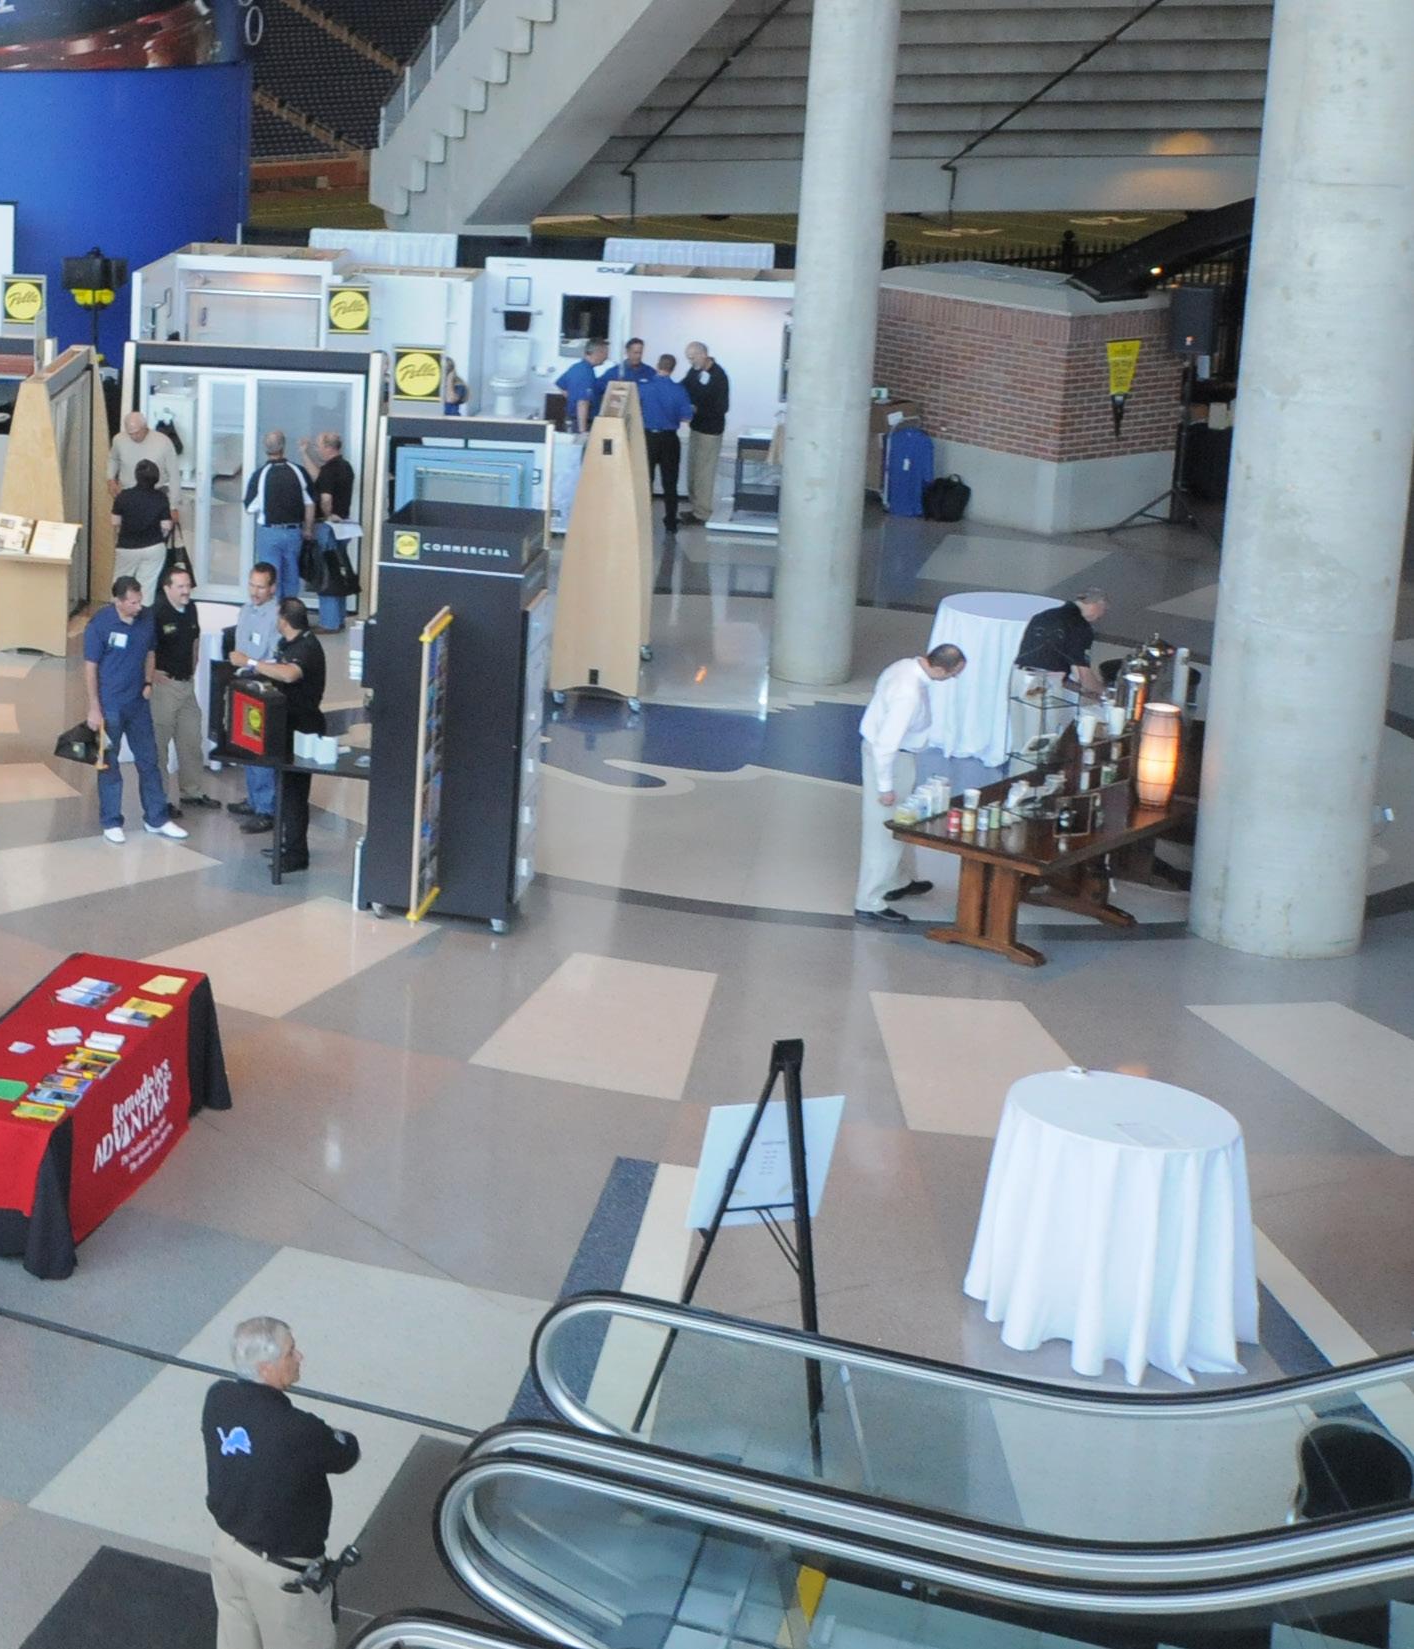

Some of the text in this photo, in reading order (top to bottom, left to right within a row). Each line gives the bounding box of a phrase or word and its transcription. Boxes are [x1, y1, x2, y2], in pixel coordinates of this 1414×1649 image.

[7, 291, 40, 308] Pella
[329, 299, 367, 318] Pella
[397, 363, 439, 386] Pella
[422, 542, 511, 559] COMMERCIAL
[93, 1080, 169, 1174] ADVANTAGE
